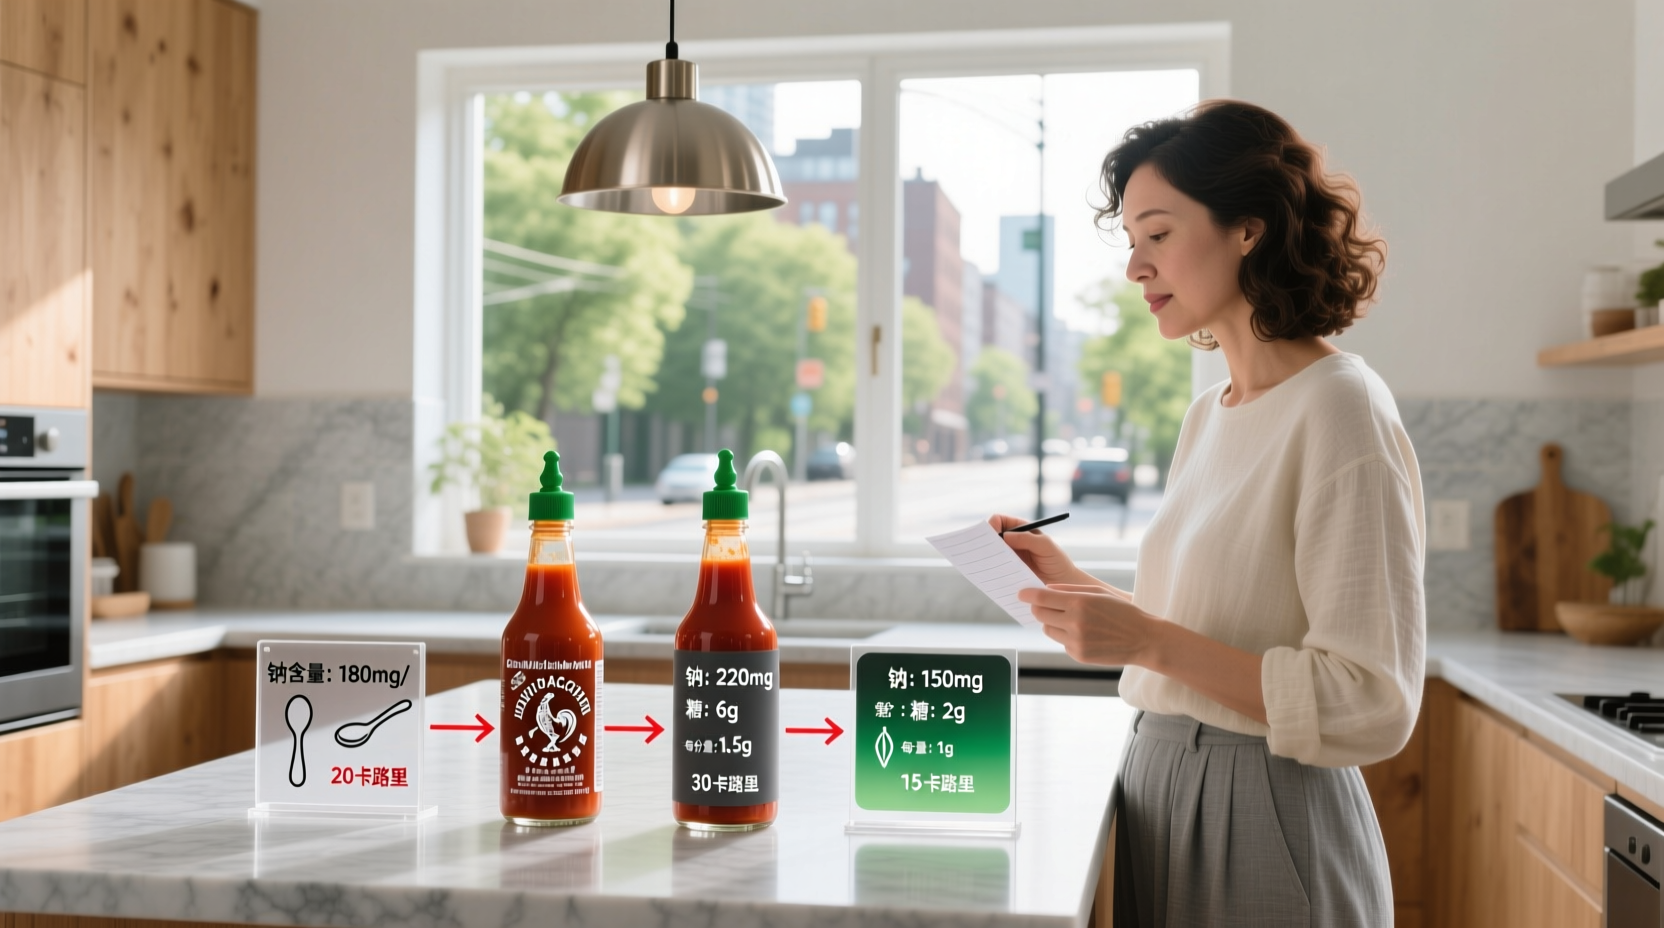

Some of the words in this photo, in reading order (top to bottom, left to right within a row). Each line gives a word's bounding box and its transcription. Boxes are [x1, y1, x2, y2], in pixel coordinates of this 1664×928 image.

[338, 664, 411, 689] 180mg/
[715, 667, 774, 691] 220mg
[921, 669, 984, 694] 150mg
[715, 700, 739, 724] 6g
[942, 701, 966, 724] 2g
[936, 740, 954, 758] 1g
[330, 765, 409, 788] 20卡路里
